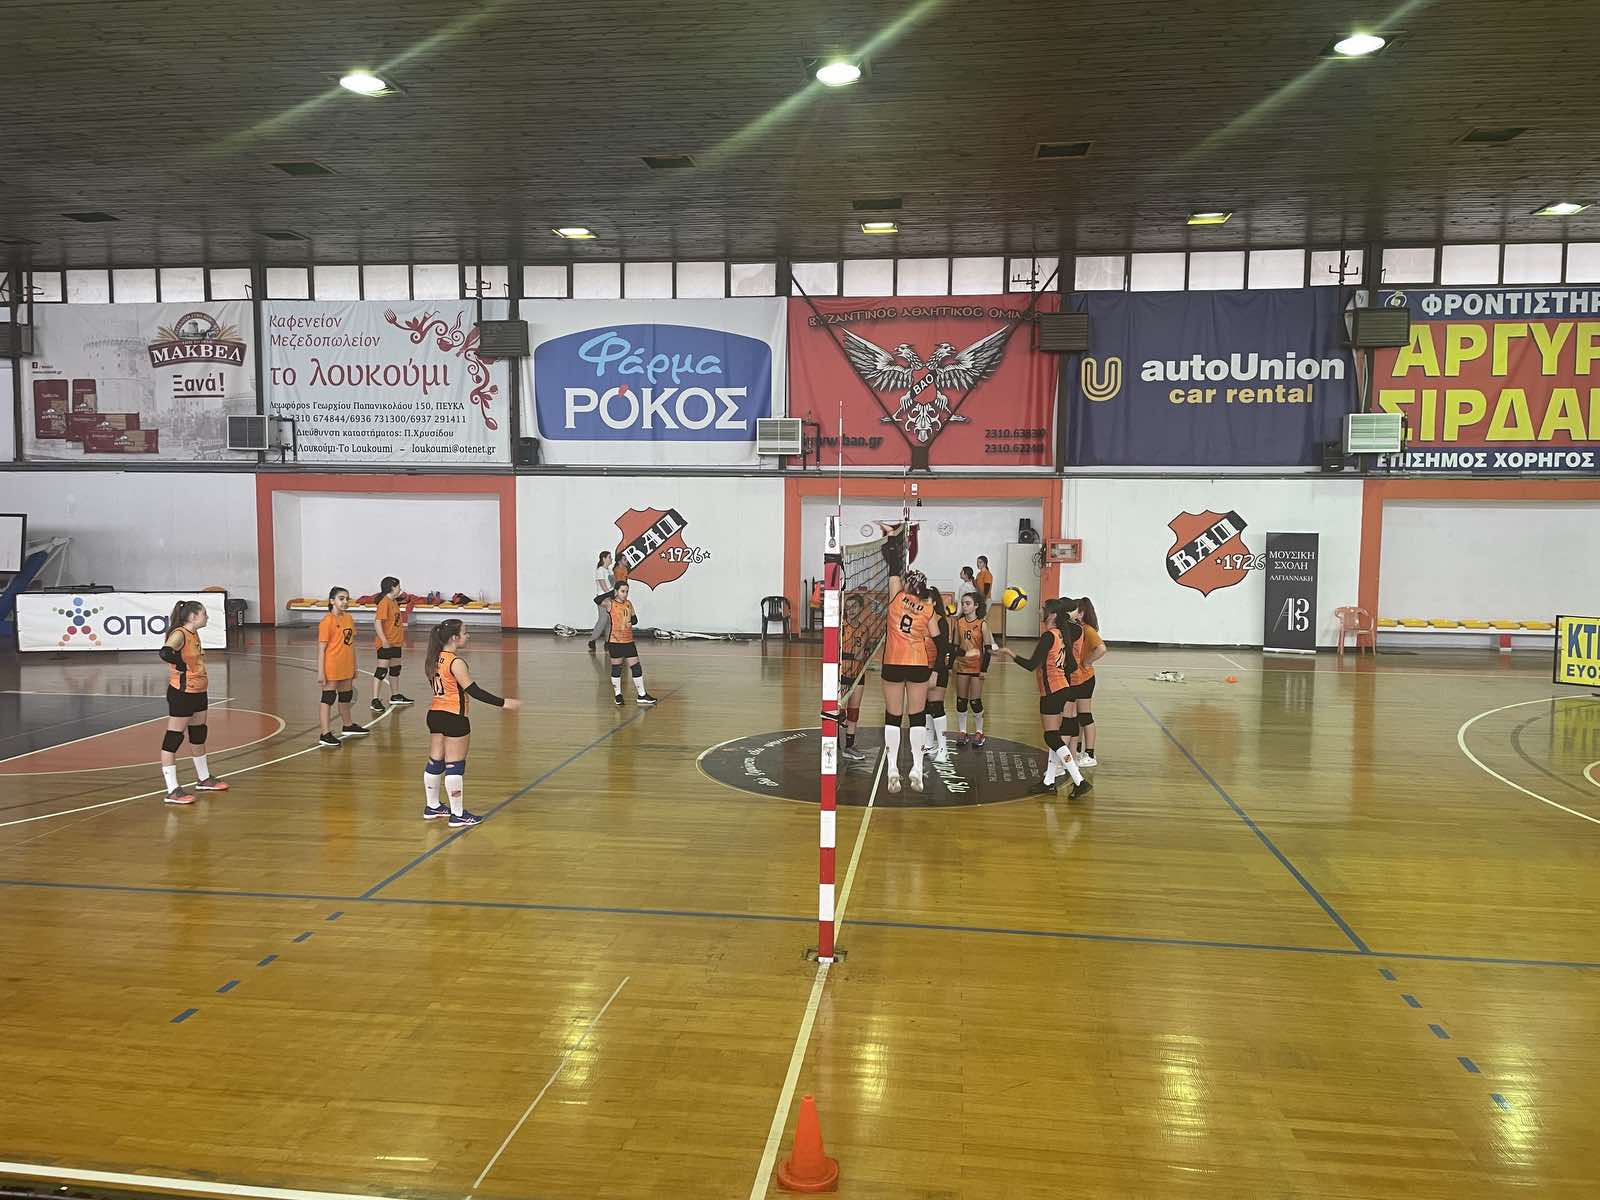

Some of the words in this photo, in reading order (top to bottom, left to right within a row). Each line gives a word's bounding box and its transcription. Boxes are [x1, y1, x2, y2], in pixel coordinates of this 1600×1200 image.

[269, 313, 342, 331] Καφενείον
[270, 332, 380, 350] Μεζεδοπωλείον
[578, 332, 722, 384] Φάρμα
[1141, 352, 1345, 382] autoUnion
[173, 373, 224, 391] Ξανά!
[270, 367, 296, 386] το
[309, 358, 450, 395] λουκούμι
[1169, 387, 1216, 404] car
[1226, 384, 1313, 404] rental
[436, 402, 465, 410] ΠΕΥΚΑ
[1379, 388, 1600, 441] ΣΙΡΔΑ
[412, 444, 496, 455] loukoumi@otenet.gr
[1493, 452, 1595, 468] ΧΟΡΗΓΟΣ
[666, 547, 704, 564] 1926
[1222, 553, 1266, 571] 1926
[1269, 551, 1315, 560] ΜΟΥΣΙΚΗ
[1274, 561, 1308, 570] ΣΧΟΛΗ
[1567, 623, 1600, 659] ΚΤ
[1567, 663, 1600, 678] ΕΥΟ
